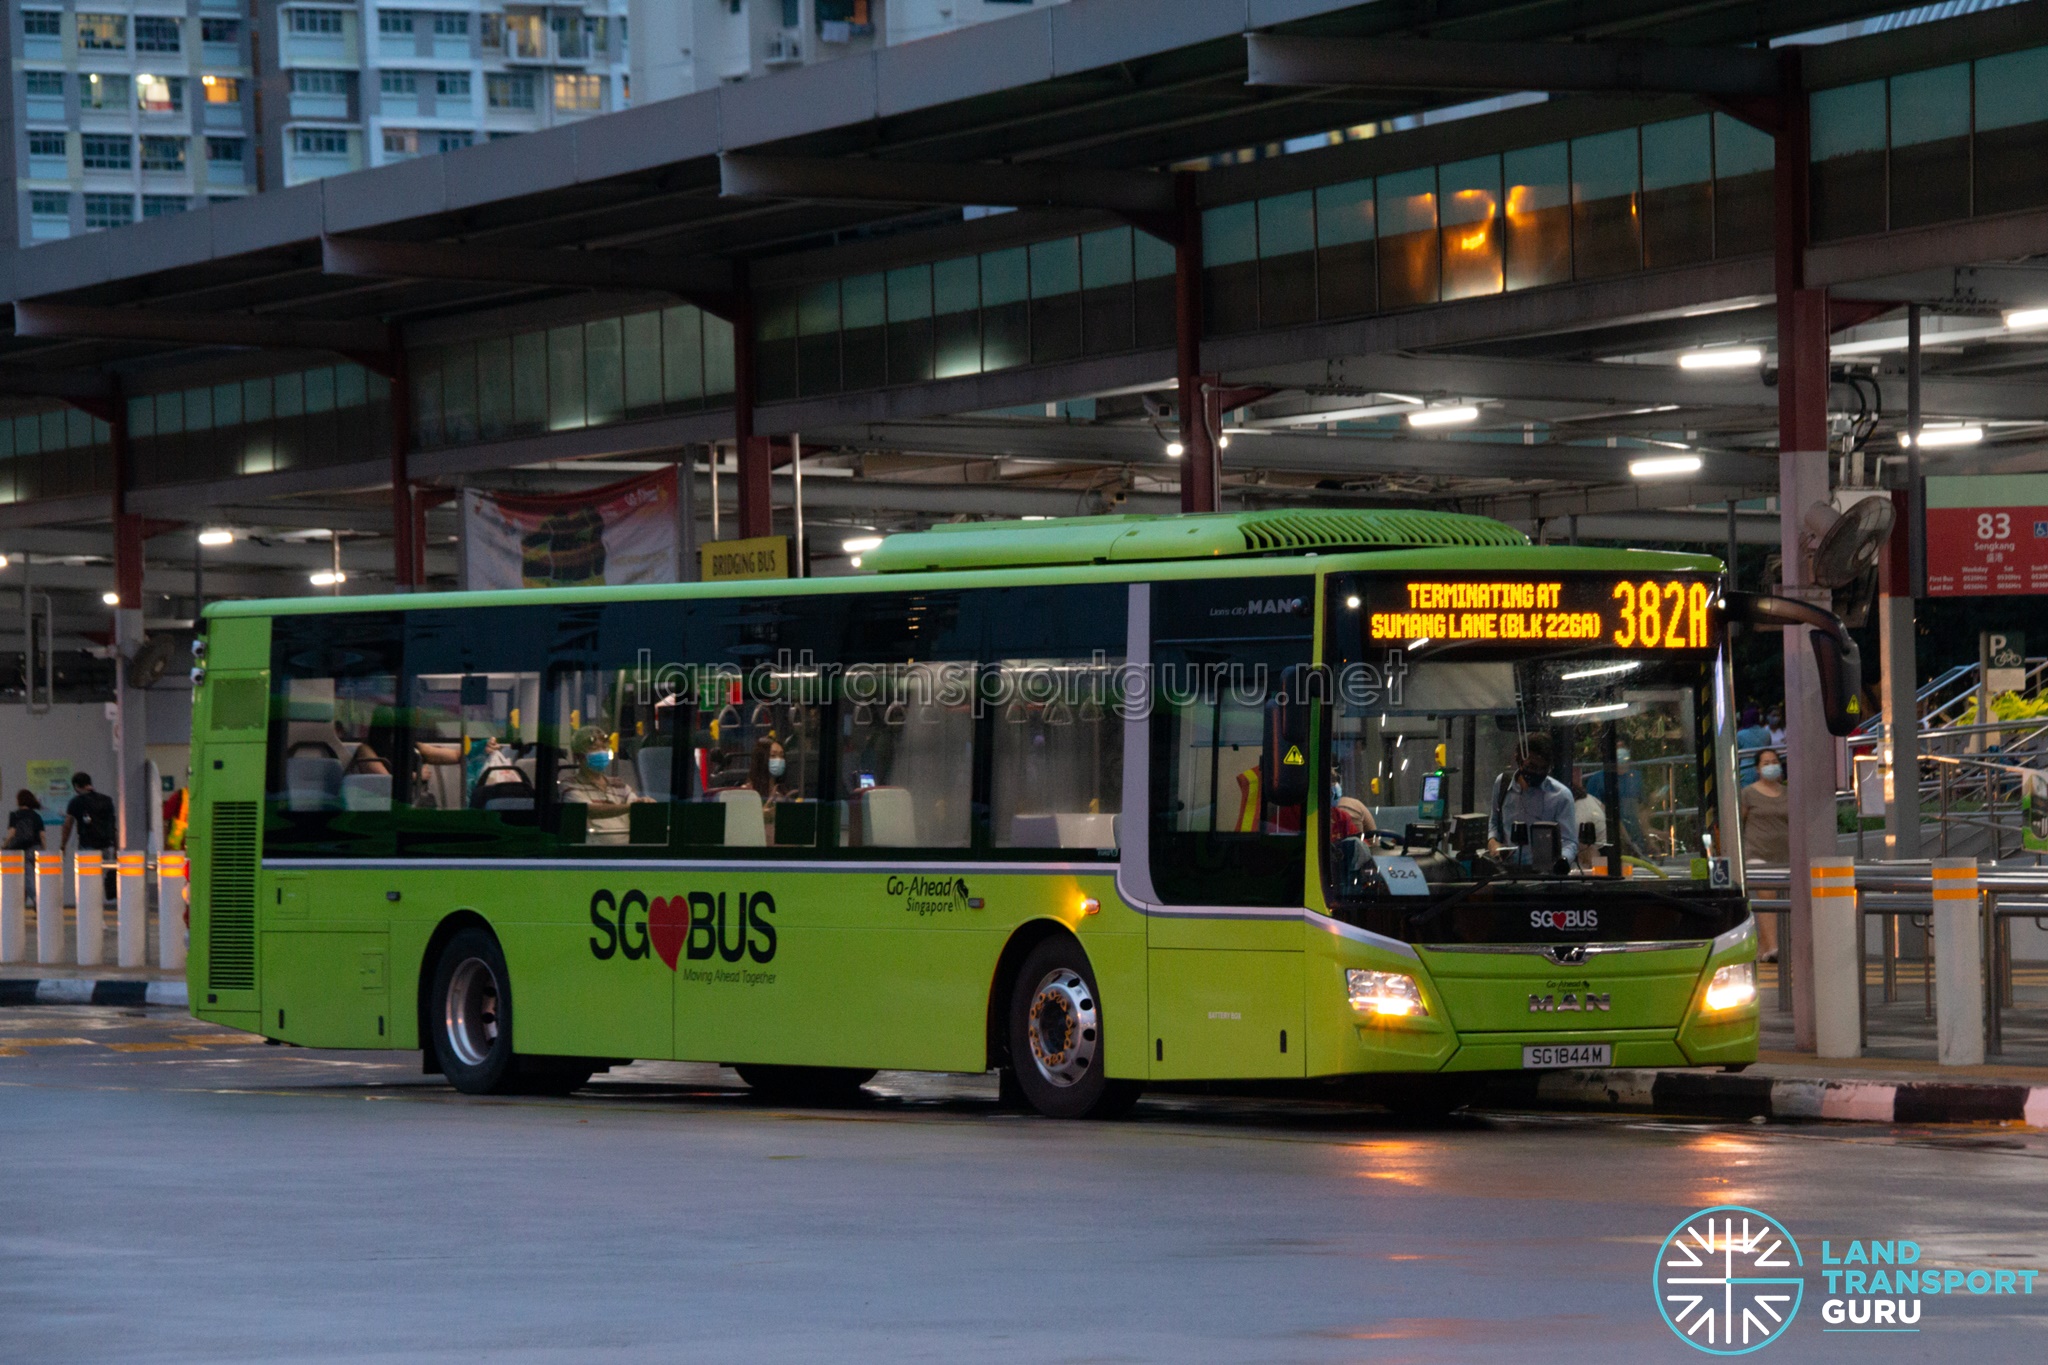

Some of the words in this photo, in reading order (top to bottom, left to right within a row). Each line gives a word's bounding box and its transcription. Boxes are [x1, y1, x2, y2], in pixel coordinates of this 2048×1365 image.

[1977, 513, 2011, 540] 83
[1974, 541, 2015, 552] Sengkang
[712, 552, 755, 576] BRIDGING
[757, 550, 775, 572] BUS
[1408, 583, 1533, 608] TERMINATING
[1536, 583, 1561, 608] AT
[1248, 599, 1292, 614] MAN
[1612, 580, 1708, 648] 382A
[1371, 613, 1447, 639] SUMANG
[1449, 613, 1498, 639] LANE
[1500, 613, 1544, 639] (BLK
[1546, 613, 1601, 639] 226A)
[1990, 635, 2007, 657] P
[1389, 869, 1417, 879] 824
[886, 876, 952, 896] Go-Ahead
[906, 897, 953, 916] Singapore
[683, 969, 713, 984] Moving
[714, 969, 740, 982] Ahead
[742, 970, 776, 986] Together
[1528, 993, 1610, 1012] MAN
[1532, 1047, 1602, 1064] SG1844M
